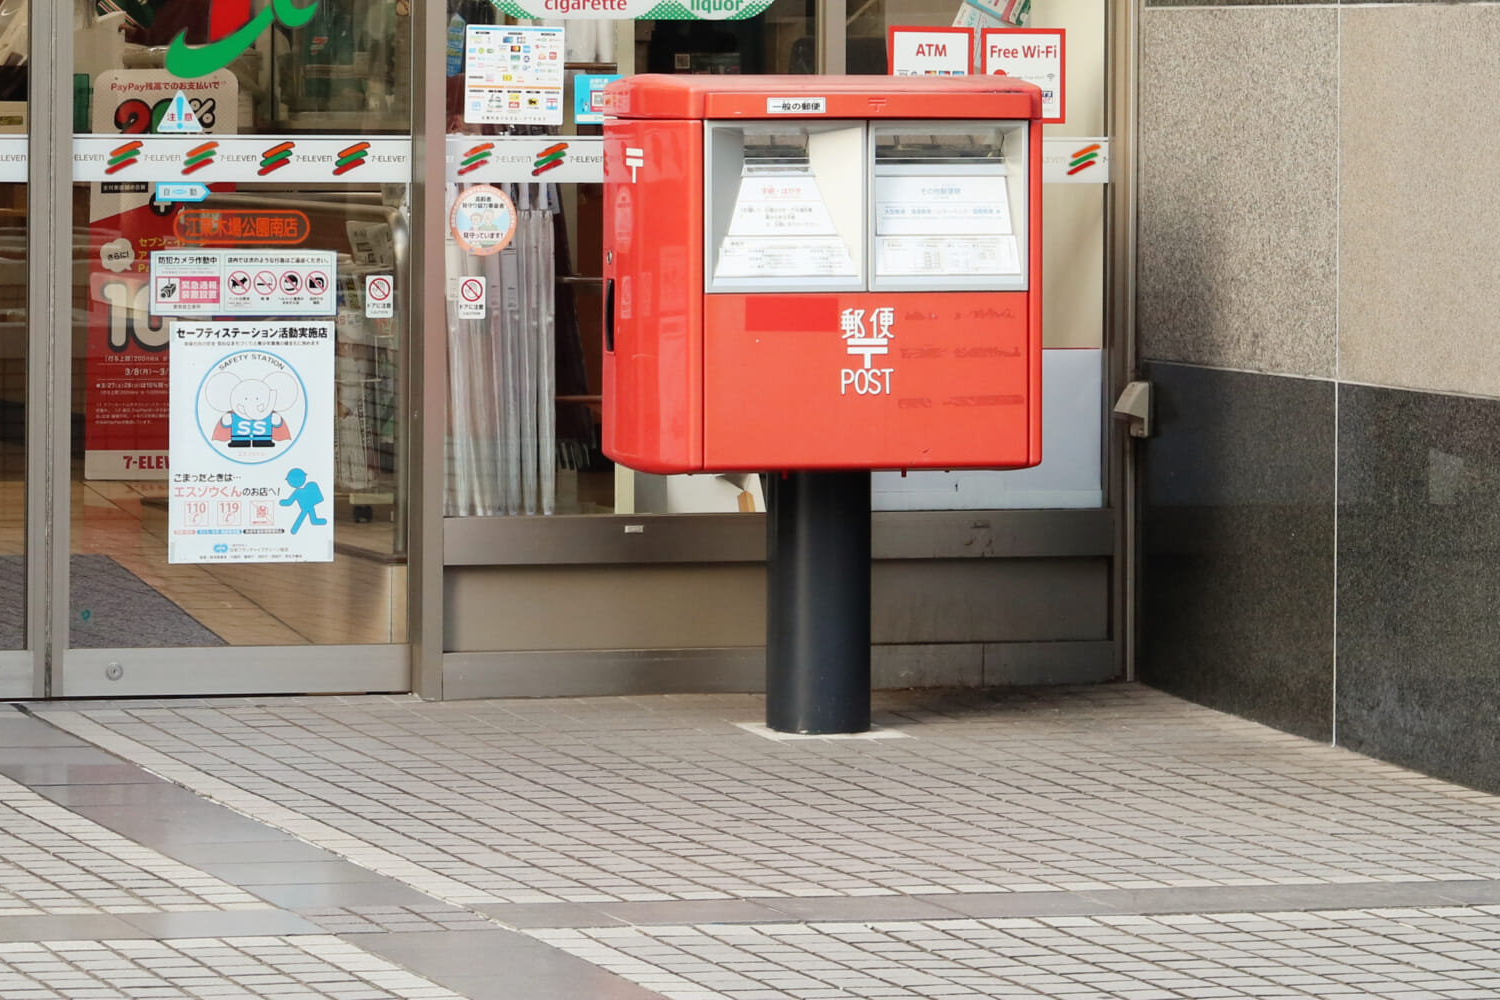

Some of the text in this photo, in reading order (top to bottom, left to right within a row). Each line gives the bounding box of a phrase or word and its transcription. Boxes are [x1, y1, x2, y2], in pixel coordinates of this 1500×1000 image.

[915, 43, 948, 57] ATM
[990, 45, 1058, 59] Free Wi-Fi
[110, 80, 220, 93] PayPay残高でのお支払いで
[771, 101, 821, 112] 一般の郵便
[184, 217, 298, 238] 江東木場公園南店
[157, 256, 218, 266] 防犯カメラ作動中
[840, 306, 896, 339] 郵便
[176, 327, 328, 340] セーフティステーション活動実施店
[218, 353, 286, 371] SAFETY STATION
[840, 367, 895, 395] POST
[237, 421, 267, 436] SS
[186, 502, 240, 514] 110 119
